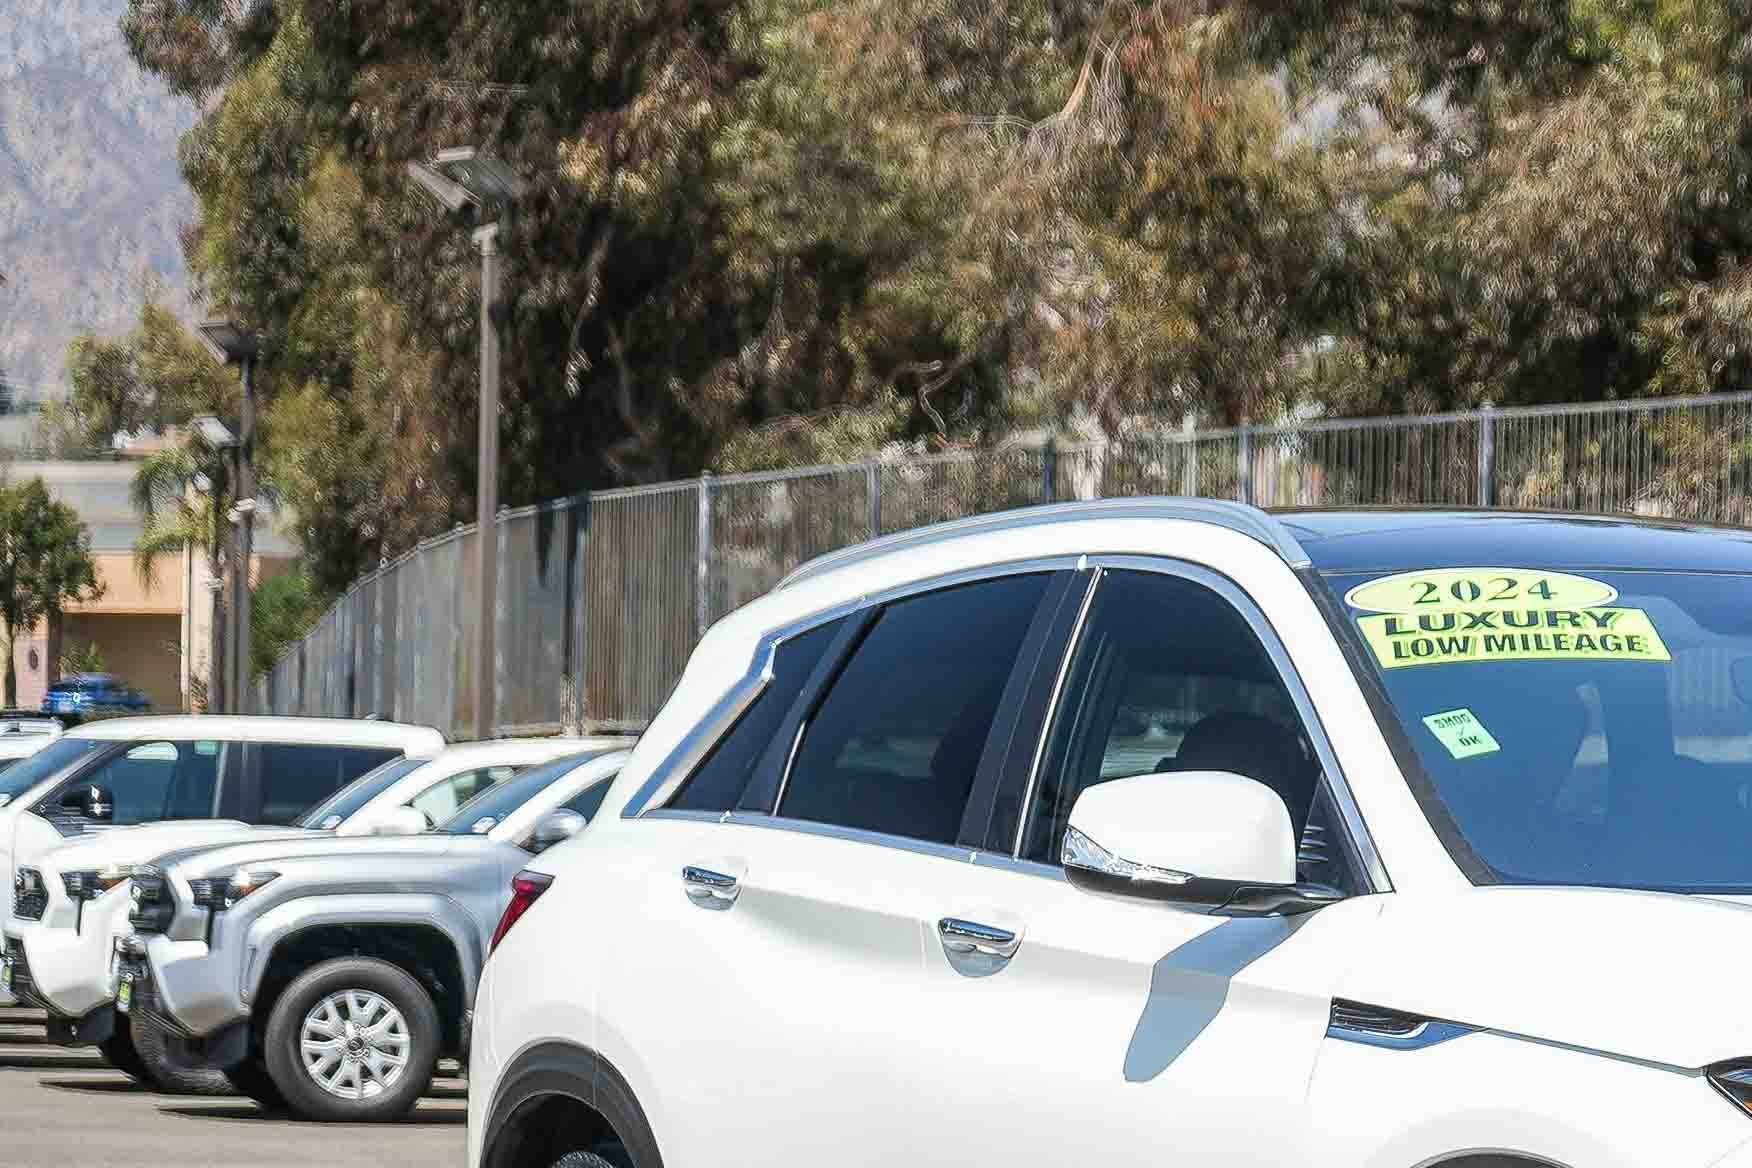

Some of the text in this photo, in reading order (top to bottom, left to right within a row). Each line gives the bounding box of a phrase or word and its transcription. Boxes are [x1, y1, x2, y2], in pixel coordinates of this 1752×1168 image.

[1410, 577, 1558, 604] 2024
[1384, 610, 1617, 636] LUXURY
[1392, 632, 1644, 660] LOW MILEAGE
